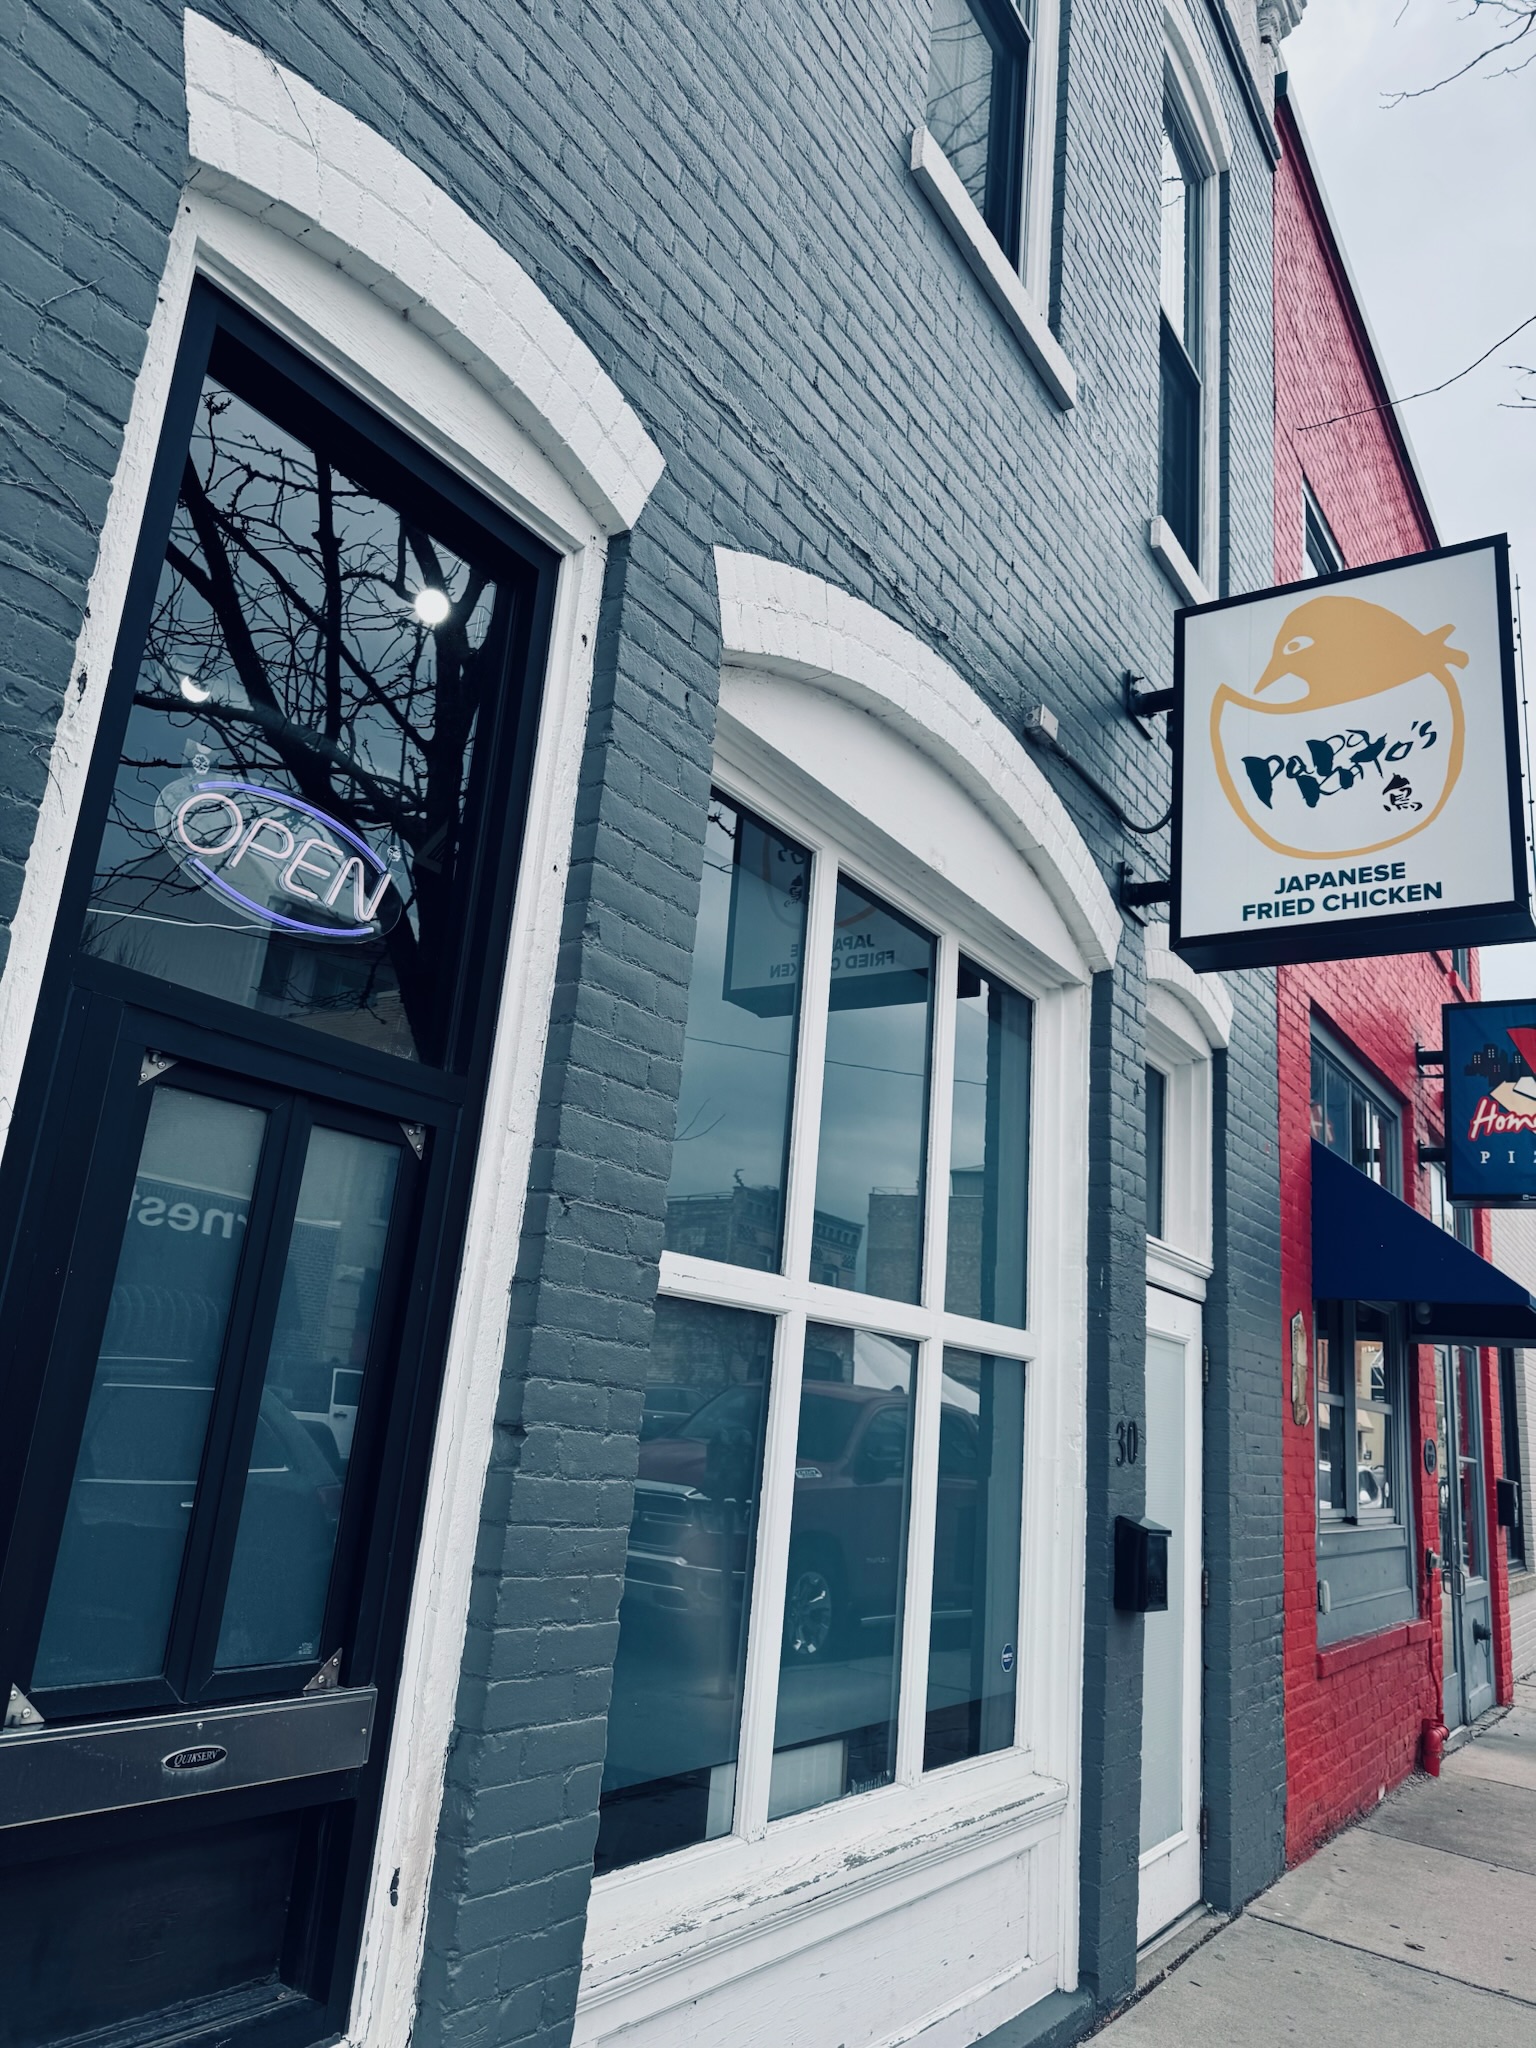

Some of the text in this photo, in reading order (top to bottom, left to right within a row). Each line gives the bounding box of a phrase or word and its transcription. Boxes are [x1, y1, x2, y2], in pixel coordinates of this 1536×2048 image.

[174, 793, 392, 922] OPEN
[1274, 862, 1406, 895] JAPANESE
[1242, 882, 1443, 921] FRIED CHICKEN
[1470, 1098, 1536, 1140] Hom
[1480, 1151, 1536, 1164] PI
[1115, 1420, 1139, 1468] 30
